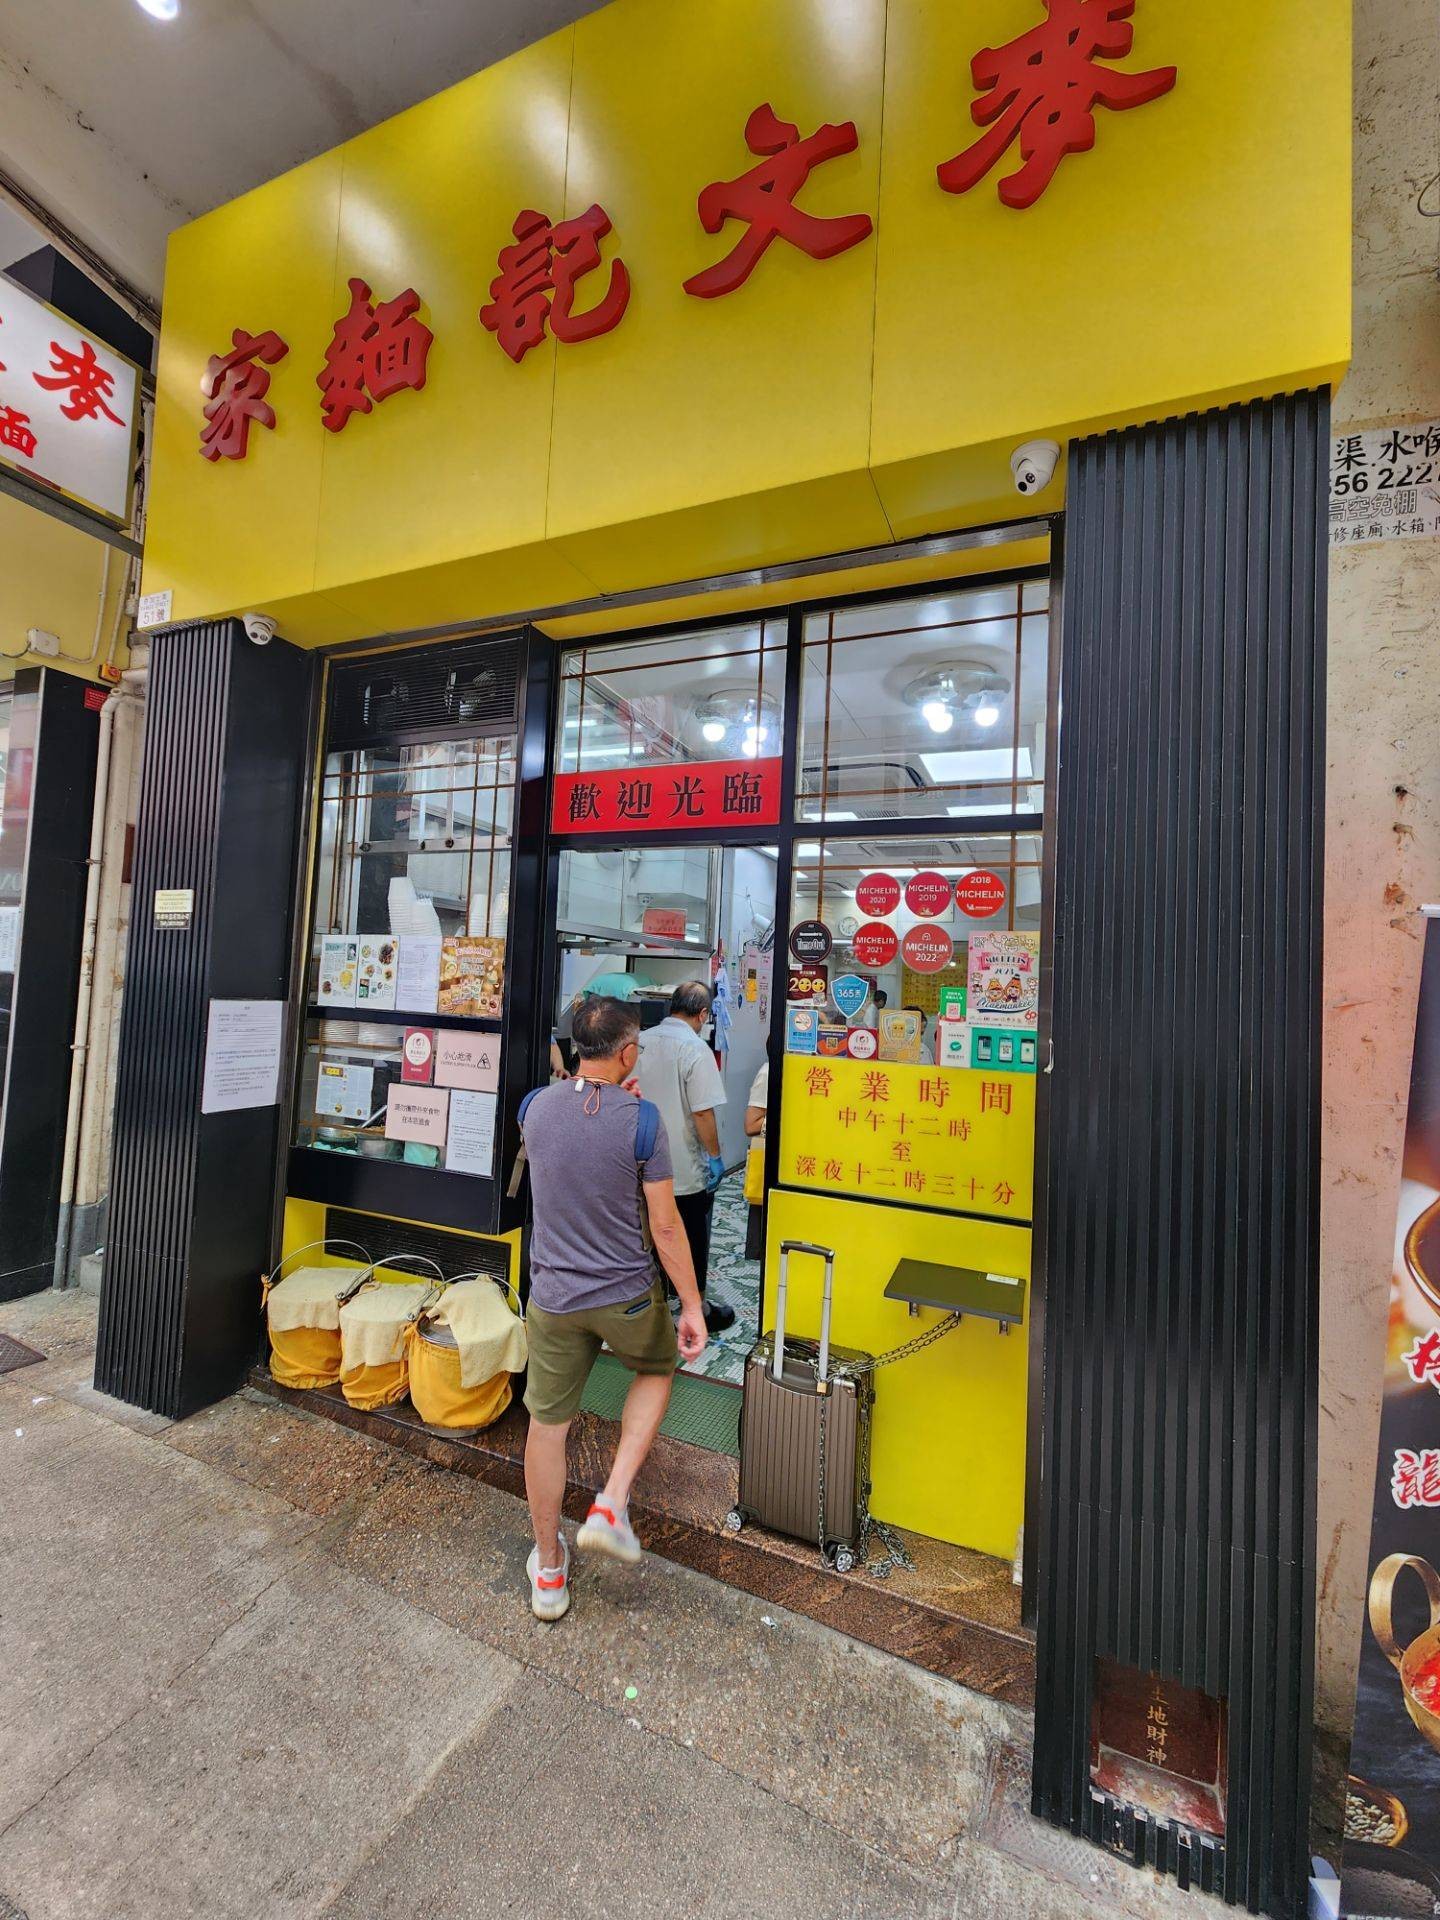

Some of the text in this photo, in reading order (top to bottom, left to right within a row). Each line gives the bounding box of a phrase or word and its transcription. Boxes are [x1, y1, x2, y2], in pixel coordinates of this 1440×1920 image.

[1328, 461, 1440, 496] 56 222
[569, 771, 763, 823] 歡迎光臨
[970, 876, 992, 884] 2018
[858, 887, 898, 895] MICHELIN
[908, 884, 949, 893] MICHELIN
[918, 893, 937, 902] 2019
[956, 889, 1005, 899] MICHELIN
[869, 896, 887, 904] 2020
[856, 936, 895, 945] MICHELIN
[866, 945, 883, 953] 2021
[905, 942, 949, 952] MICHELIN
[915, 952, 937, 962] 2022
[805, 1066, 1012, 1116] 營業時間
[838, 1106, 972, 1142] 中午十二時
[890, 1141, 912, 1163] 至
[796, 1155, 1015, 1206] 深夜十二時三十分
